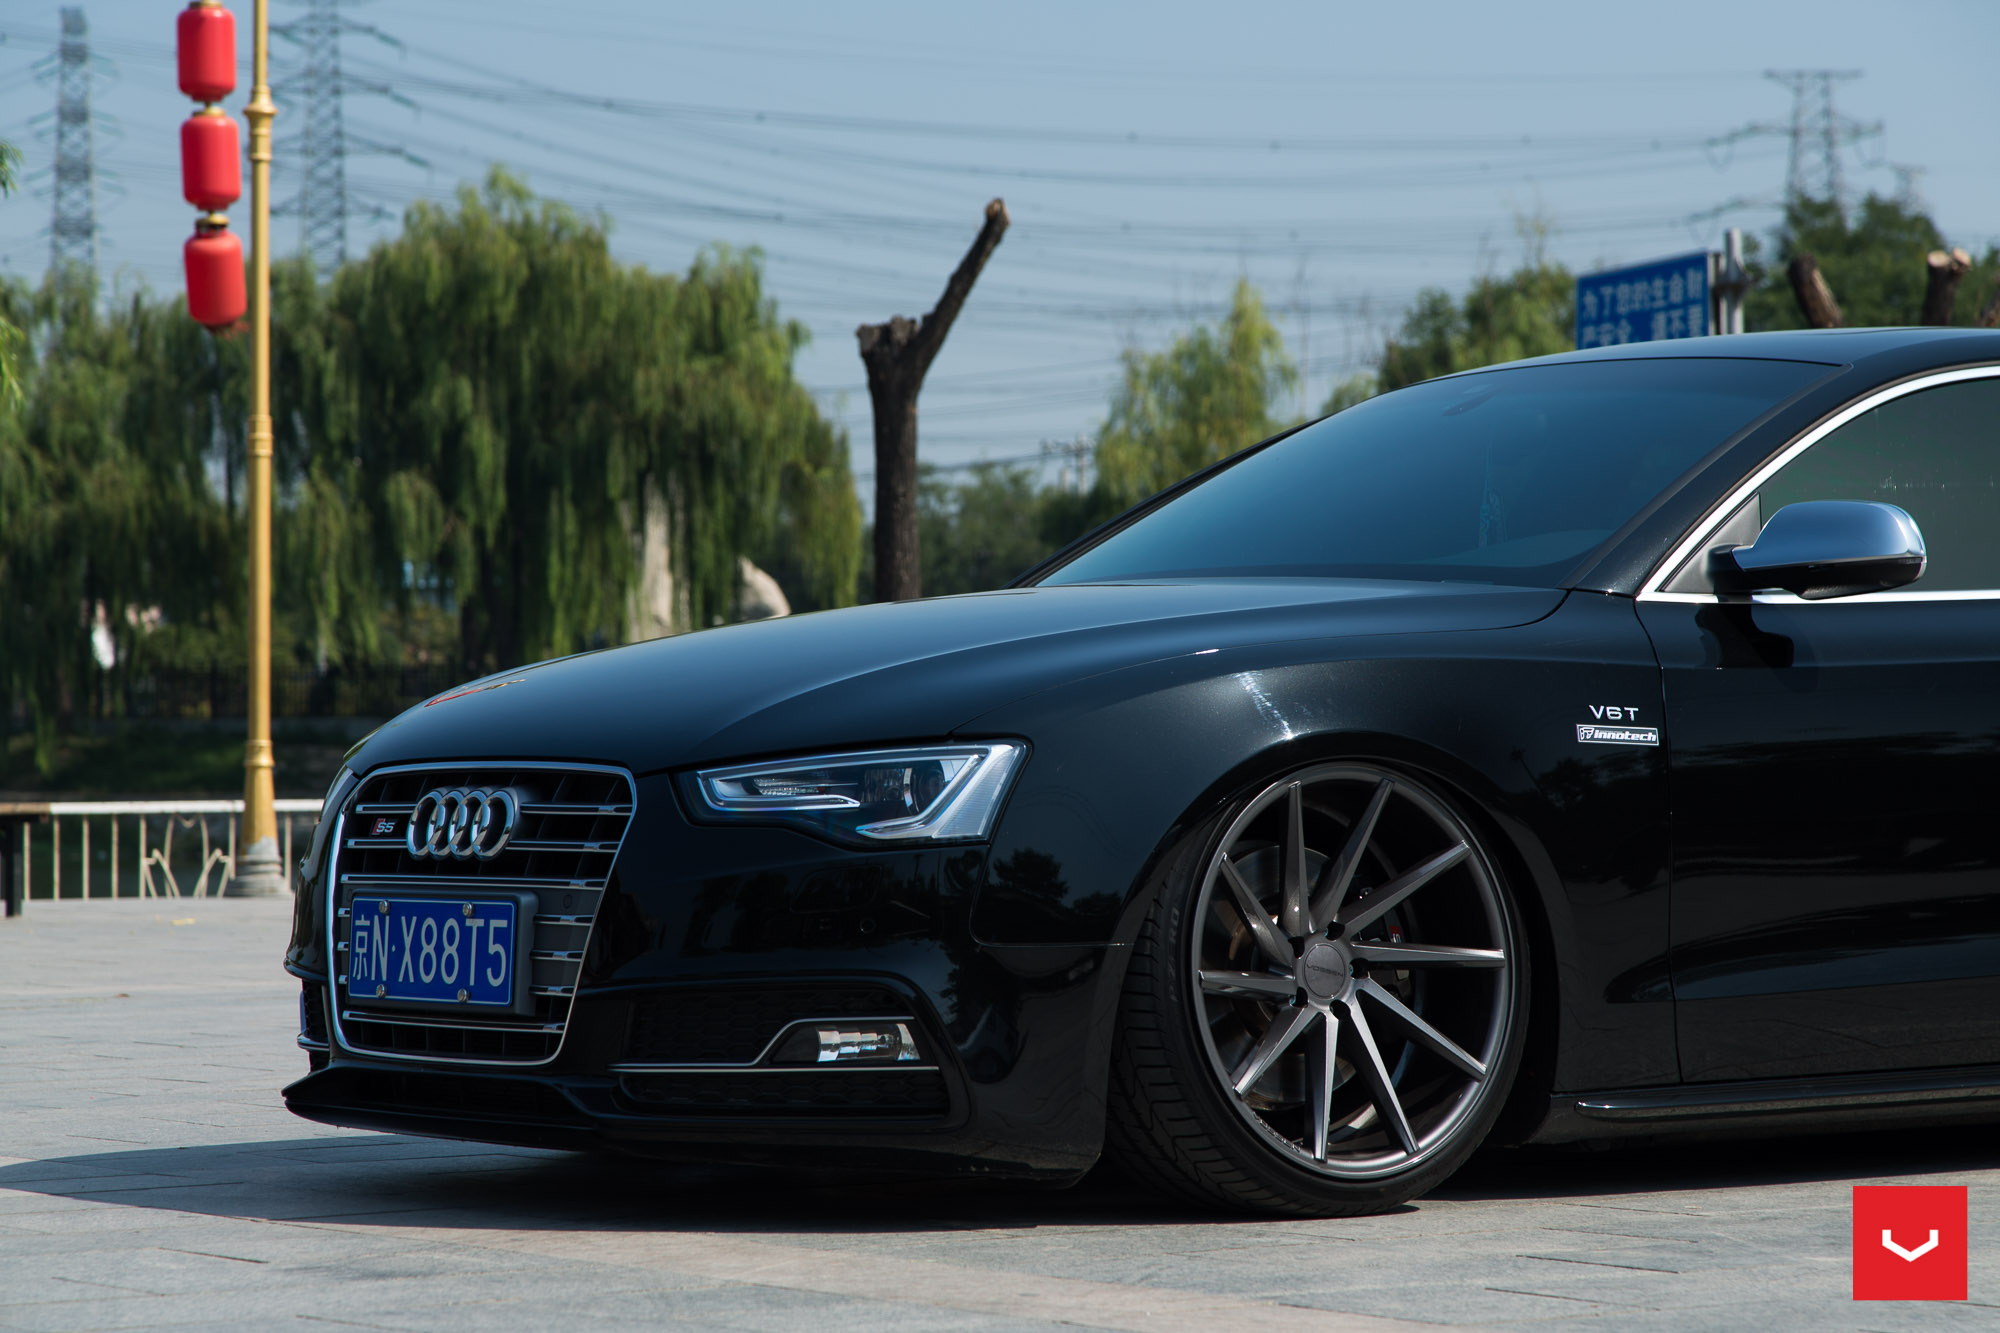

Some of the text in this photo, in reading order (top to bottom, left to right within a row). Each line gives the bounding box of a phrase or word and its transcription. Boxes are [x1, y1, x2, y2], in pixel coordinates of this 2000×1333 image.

[1588, 704, 1639, 721] V6T
[1593, 729, 1657, 742] innotech
[375, 821, 396, 833] S5
